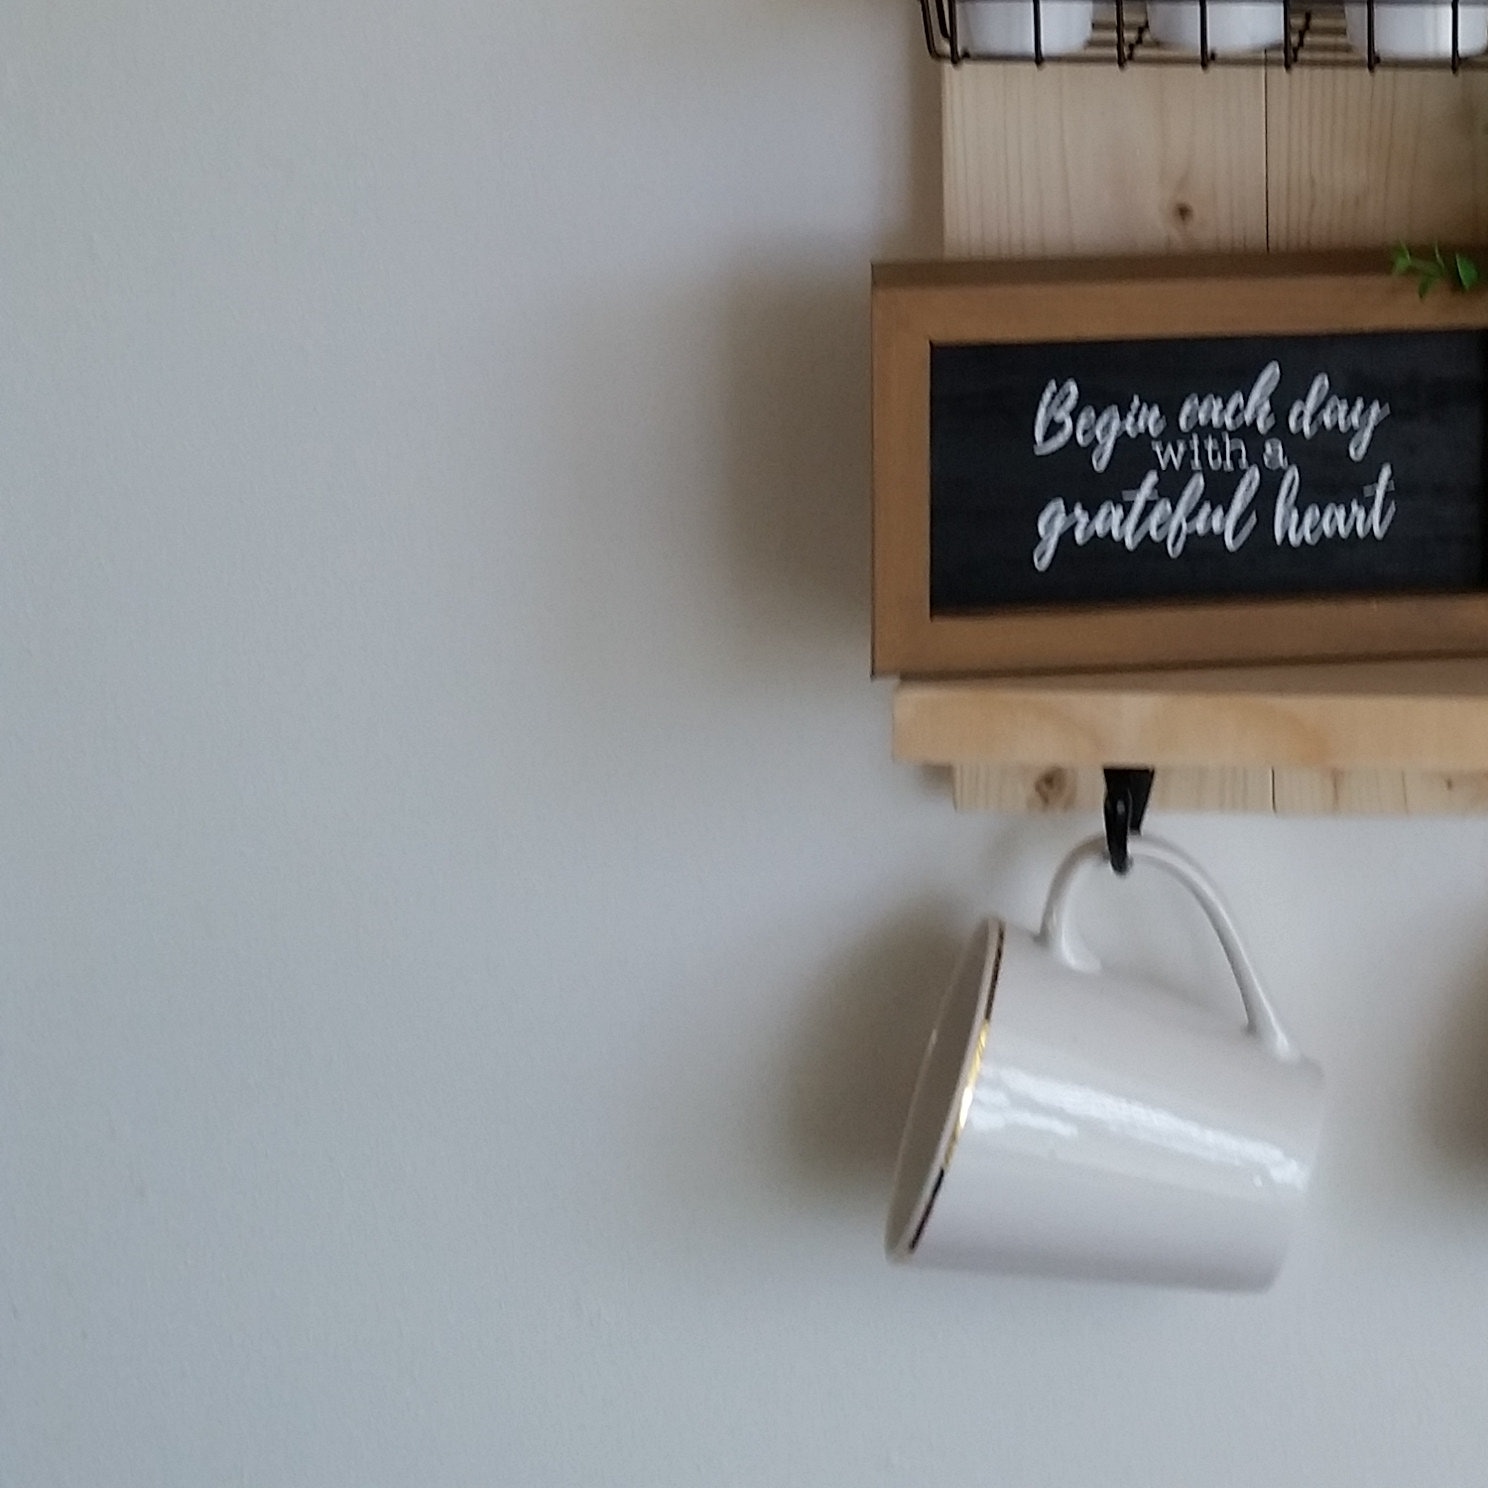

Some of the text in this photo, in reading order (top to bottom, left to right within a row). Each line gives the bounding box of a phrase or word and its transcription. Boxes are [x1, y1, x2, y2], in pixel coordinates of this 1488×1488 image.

[1033, 359, 1391, 473] Begin each day
[1151, 431, 1289, 472] with a
[1033, 462, 1397, 573] grateful heart
